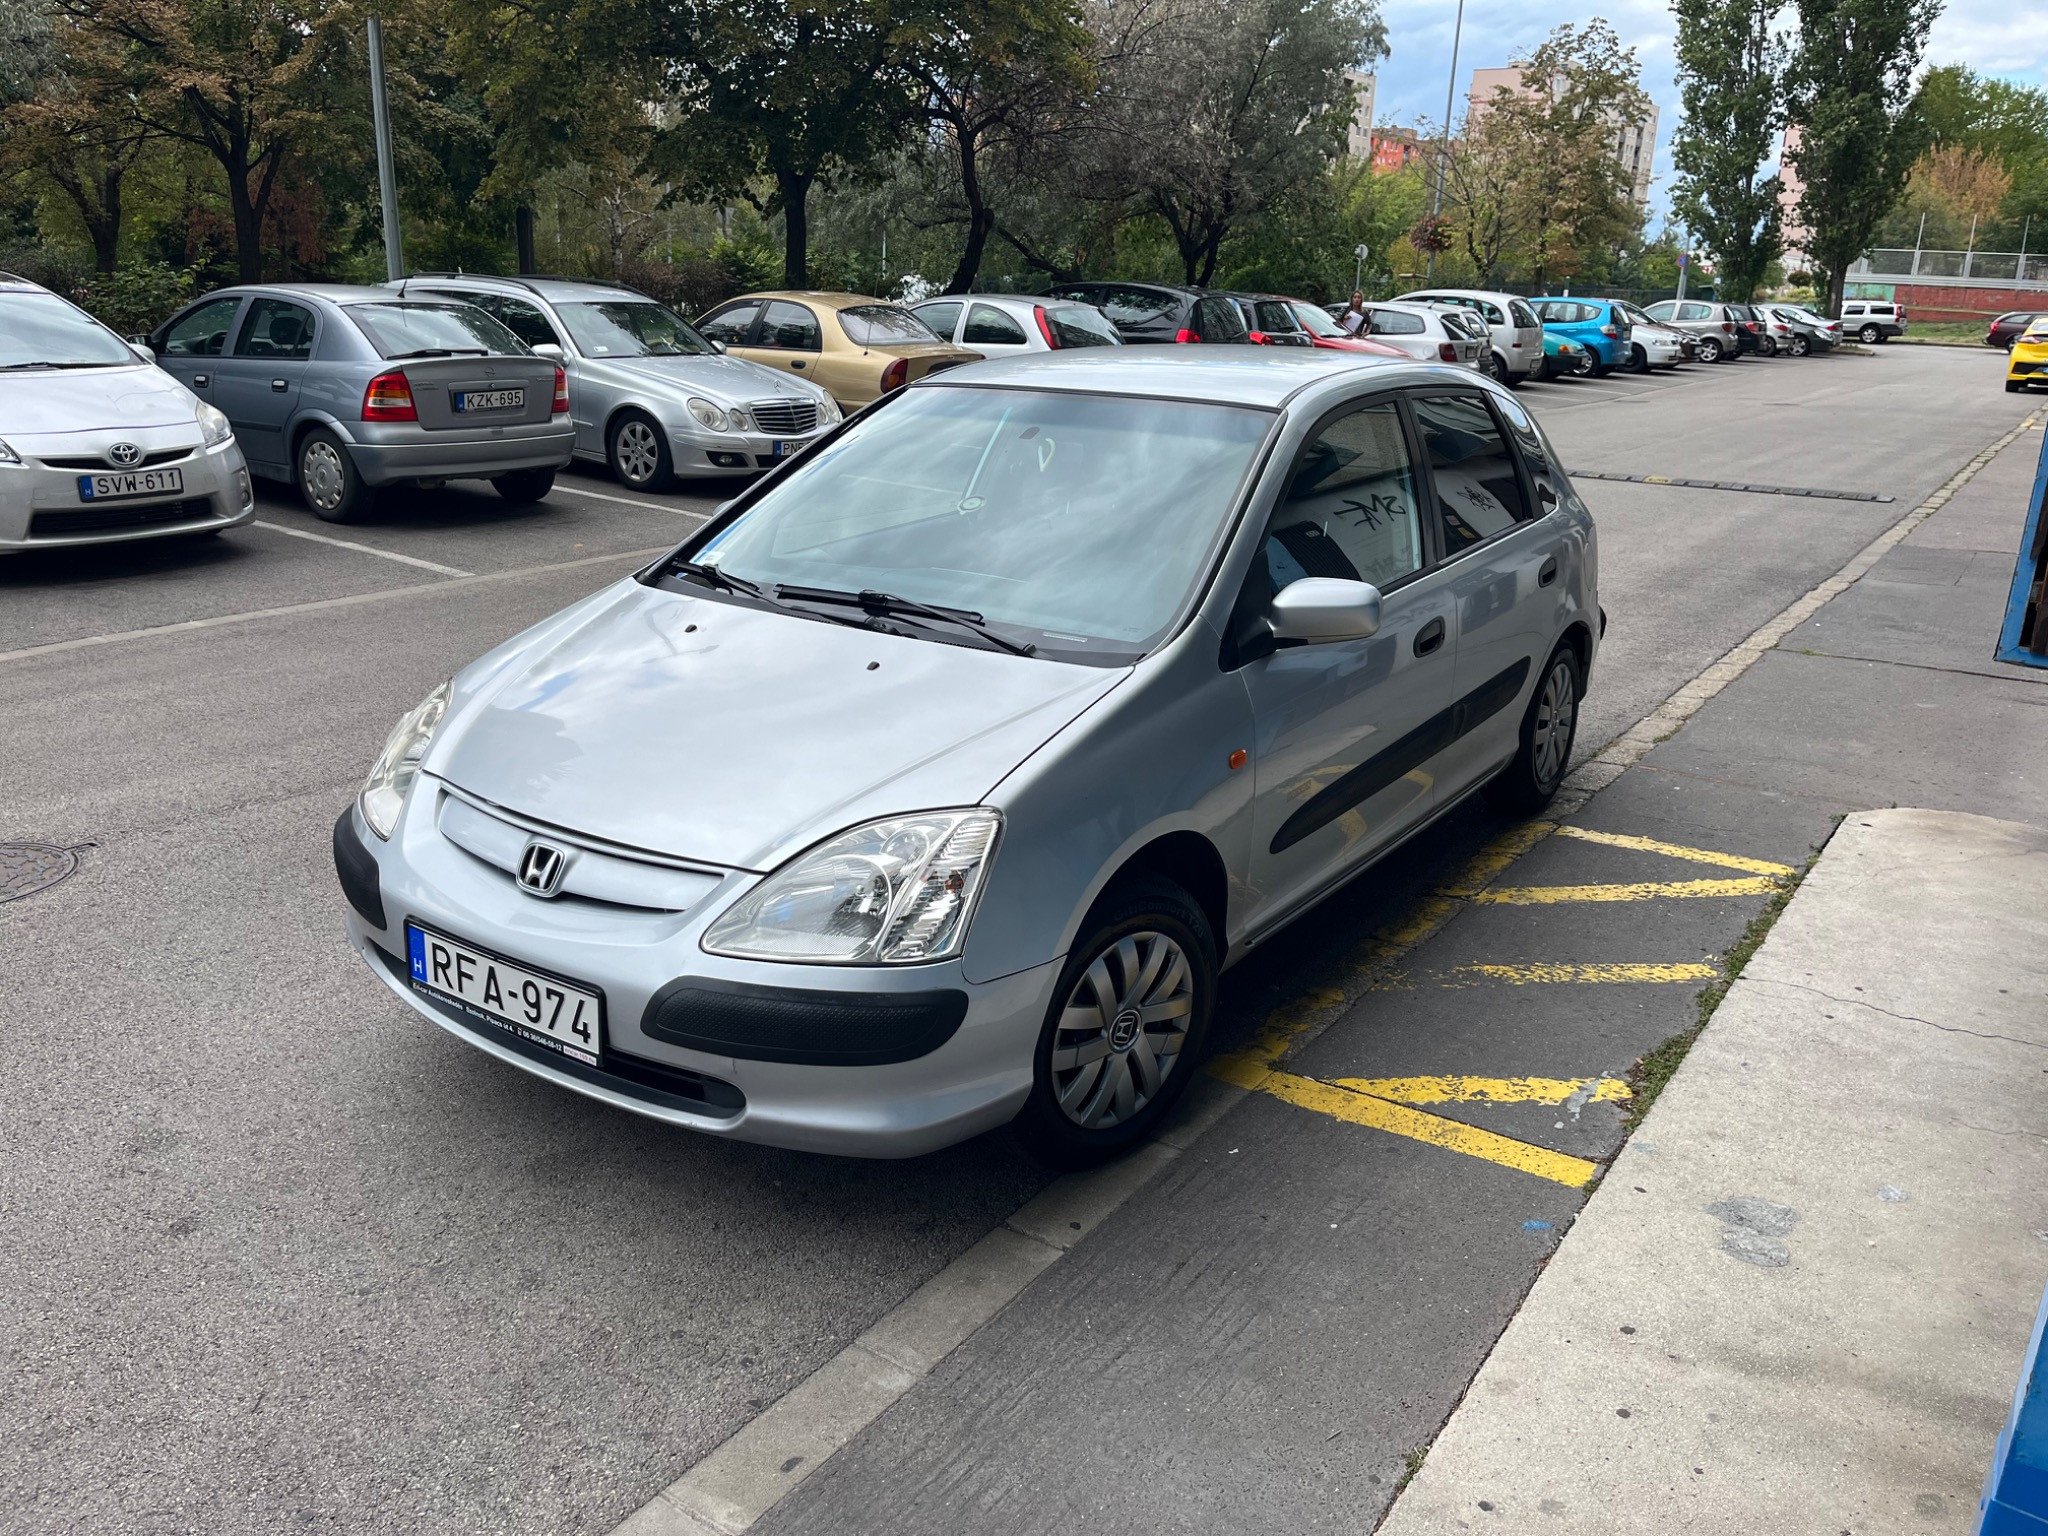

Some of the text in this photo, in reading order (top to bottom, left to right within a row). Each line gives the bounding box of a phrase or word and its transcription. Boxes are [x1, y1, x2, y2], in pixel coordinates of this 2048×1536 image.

[467, 391, 521, 408] KZK-695
[97, 471, 176, 494] SVW-611
[413, 958, 423, 974] H
[431, 942, 591, 1044] RFA-974
